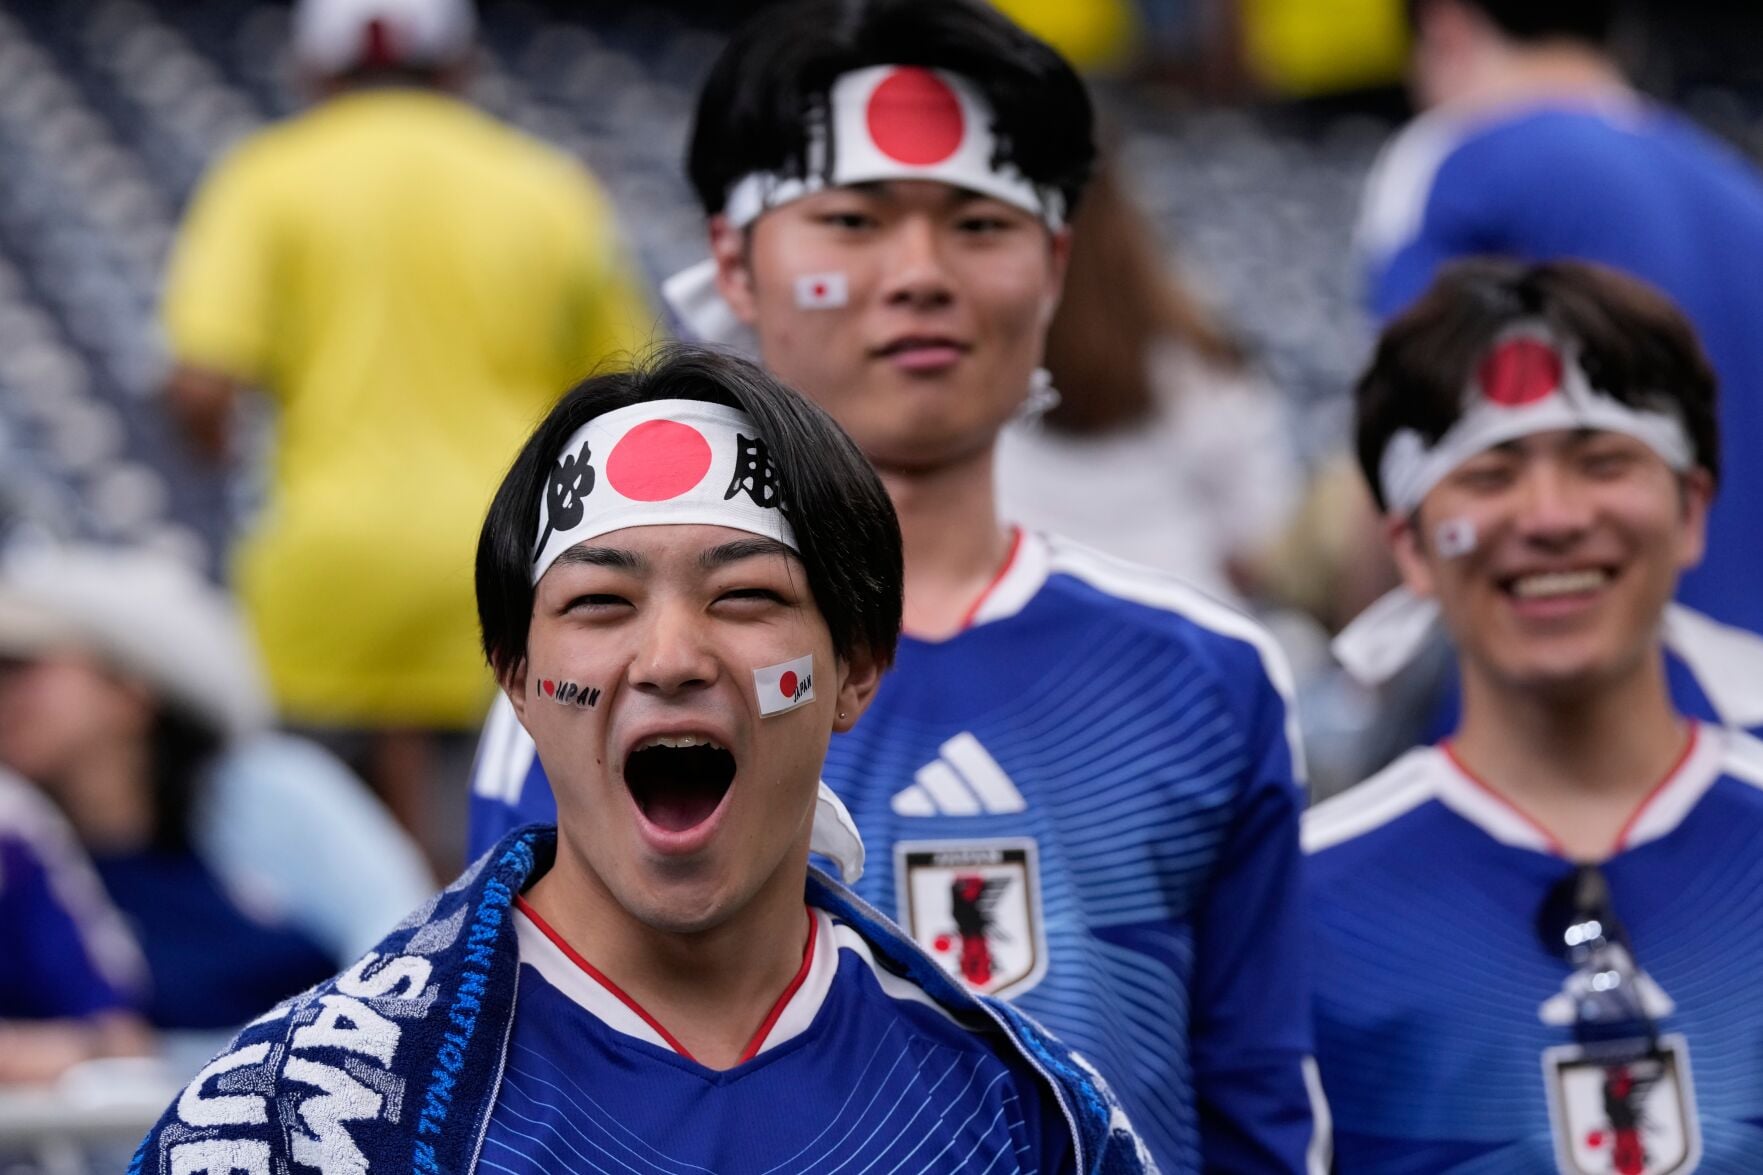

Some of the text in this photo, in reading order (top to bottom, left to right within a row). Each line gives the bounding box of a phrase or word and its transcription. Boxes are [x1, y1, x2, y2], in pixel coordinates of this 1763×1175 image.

[536, 678, 601, 707] I JAPAN
[793, 674, 812, 703] JAPAN
[464, 876, 512, 969] JAPAN
[416, 971, 489, 1134] NATIONAL
